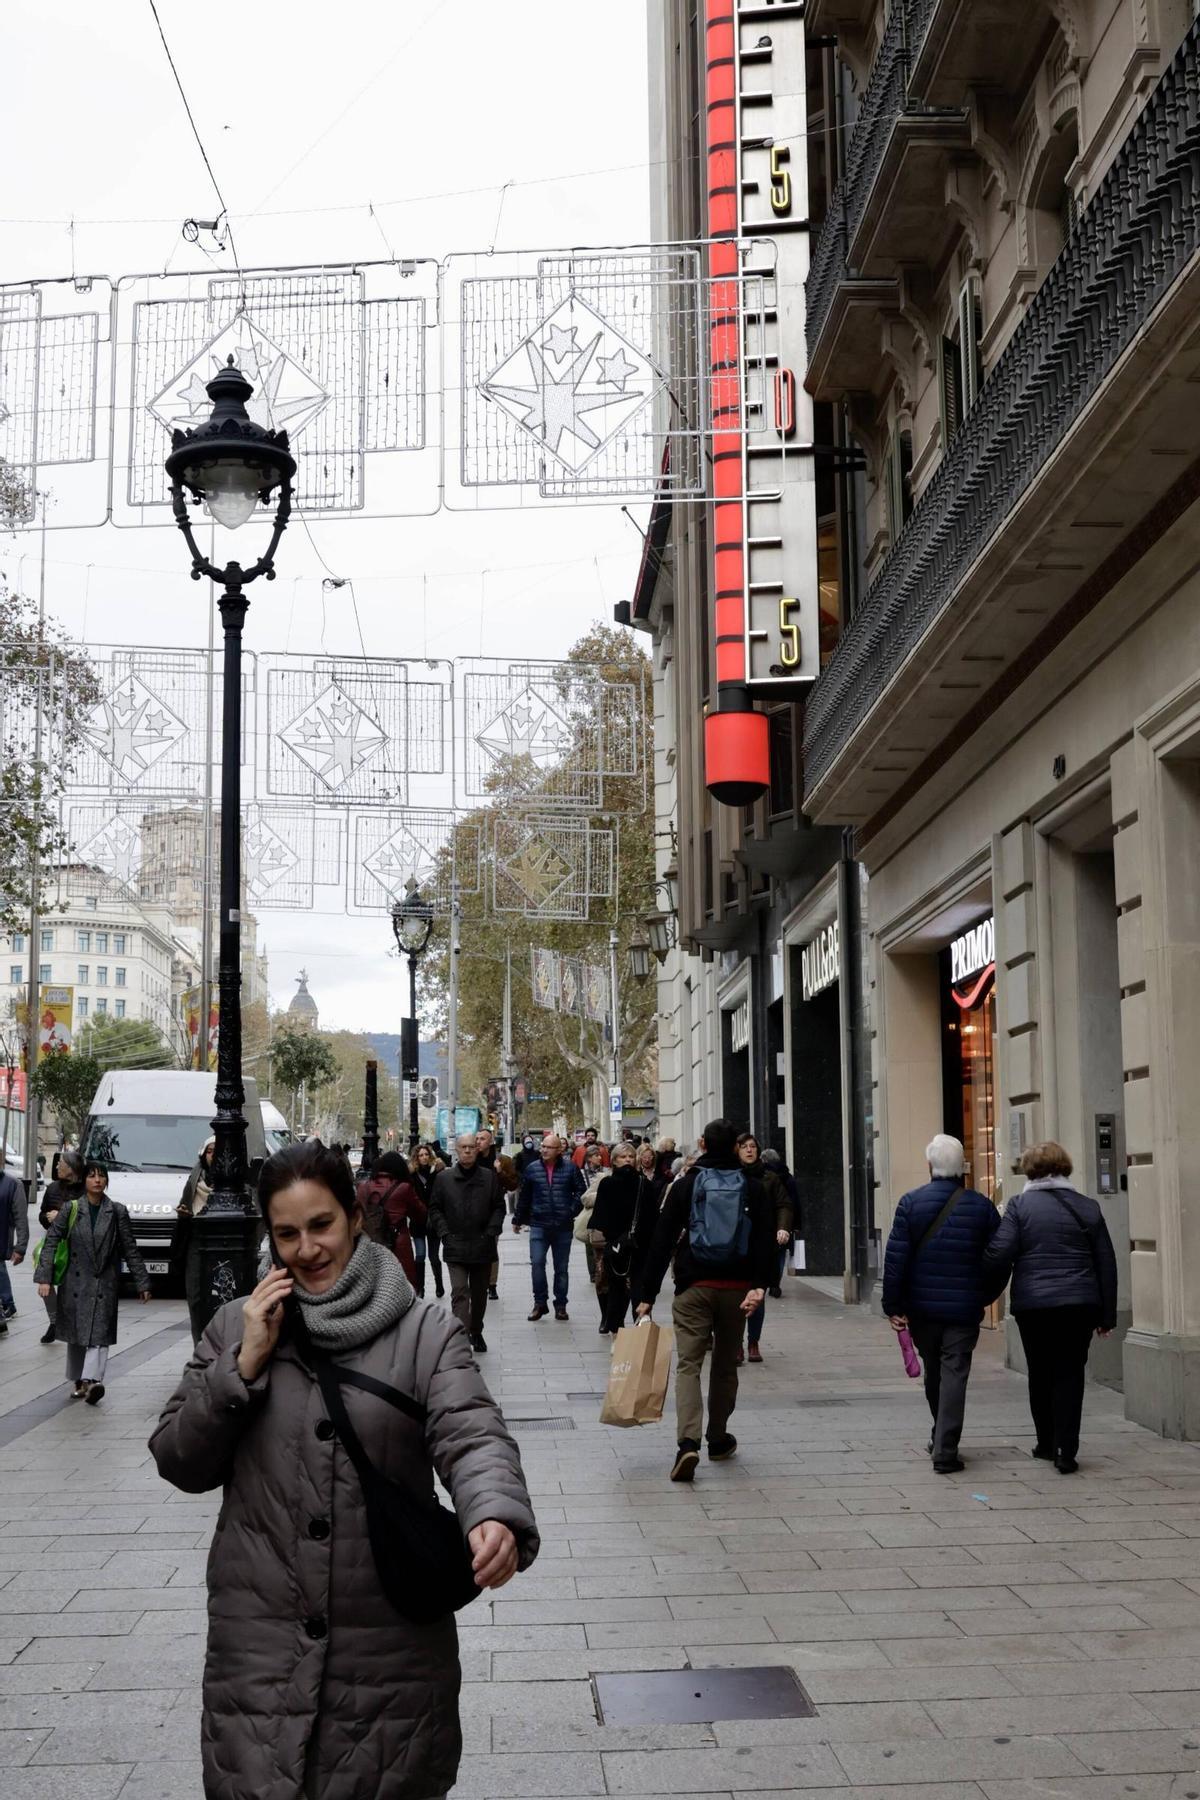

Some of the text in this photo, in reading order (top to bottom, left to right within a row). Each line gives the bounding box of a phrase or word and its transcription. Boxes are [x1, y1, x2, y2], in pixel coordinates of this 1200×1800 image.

[770, 147, 791, 213] 5
[775, 368, 795, 434] 0
[780, 598, 801, 668] 5
[611, 1097, 620, 1111] P
